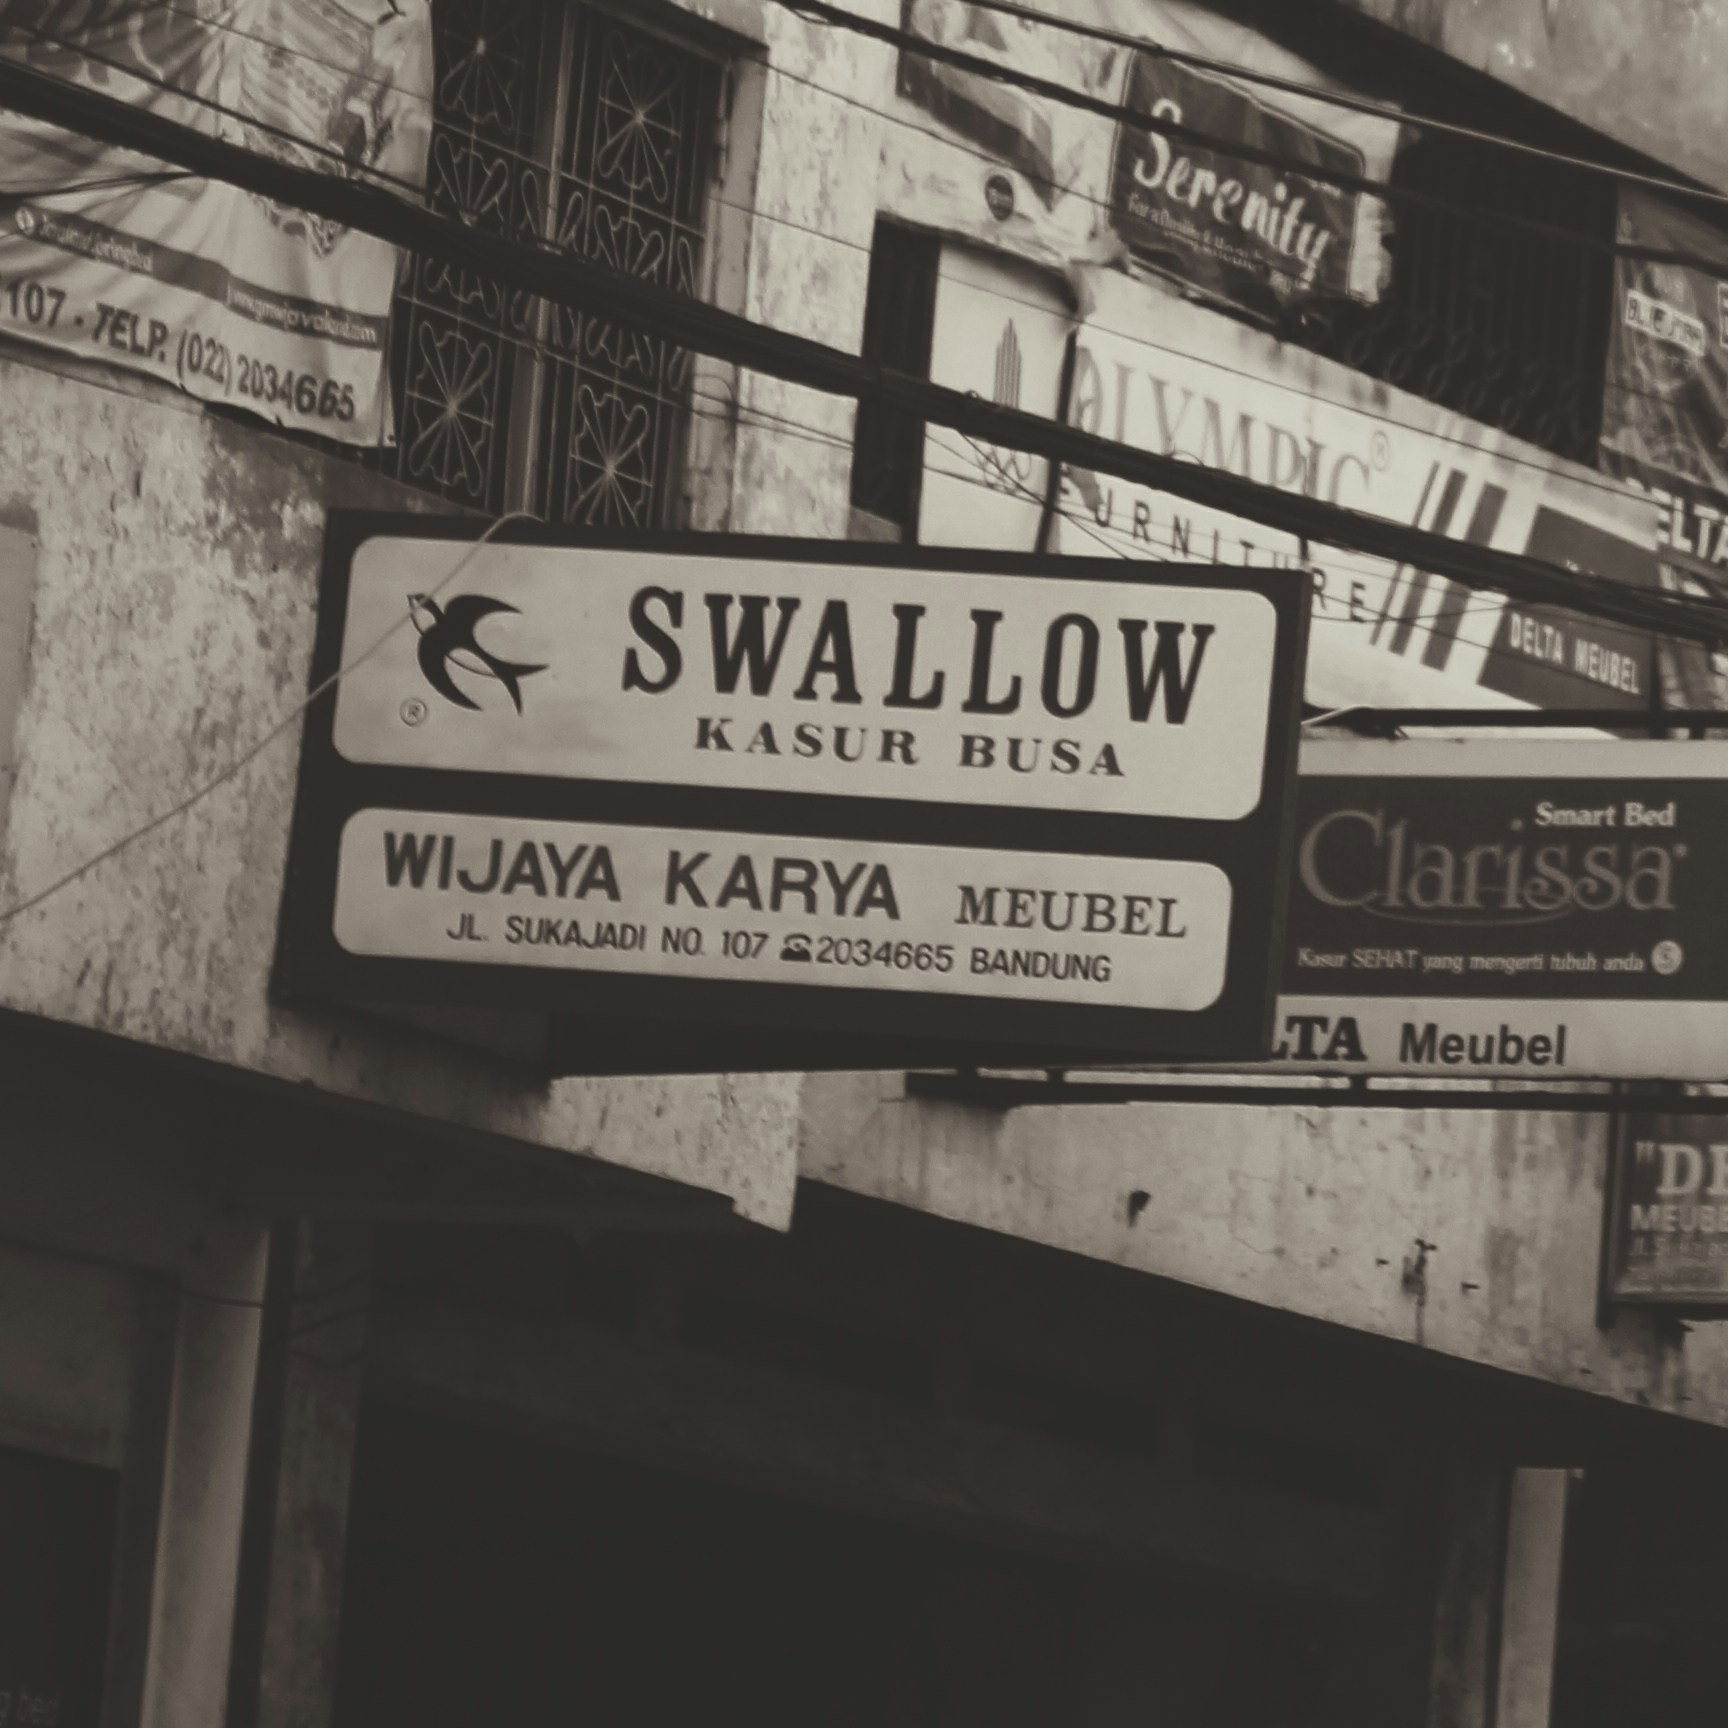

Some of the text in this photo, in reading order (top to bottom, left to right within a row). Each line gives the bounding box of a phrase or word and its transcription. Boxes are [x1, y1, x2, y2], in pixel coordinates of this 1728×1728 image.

[1134, 98, 1330, 290] Serenity
[6, 278, 65, 327] 107
[92, 302, 168, 362] TELP.
[237, 353, 355, 421] 2034665
[622, 586, 1215, 725] SWALLOW
[1510, 612, 1640, 695] DELTA MEUBEL
[695, 718, 1125, 777] KASUR BUSA
[1535, 803, 1676, 828] Smart Bed
[383, 832, 1187, 939] WIJAYA KARYA MEUBEL
[1301, 809, 1677, 911] Clarissa
[446, 914, 488, 942] JL.
[504, 916, 646, 952] SUKAJADI
[722, 931, 769, 959] 107
[816, 936, 955, 972] 2034665
[970, 946, 1112, 983] BANDUNG
[1298, 947, 1644, 973] Kasur SEHAT yang mengerti tubuh anda
[1400, 1023, 1566, 1065] Meubel
